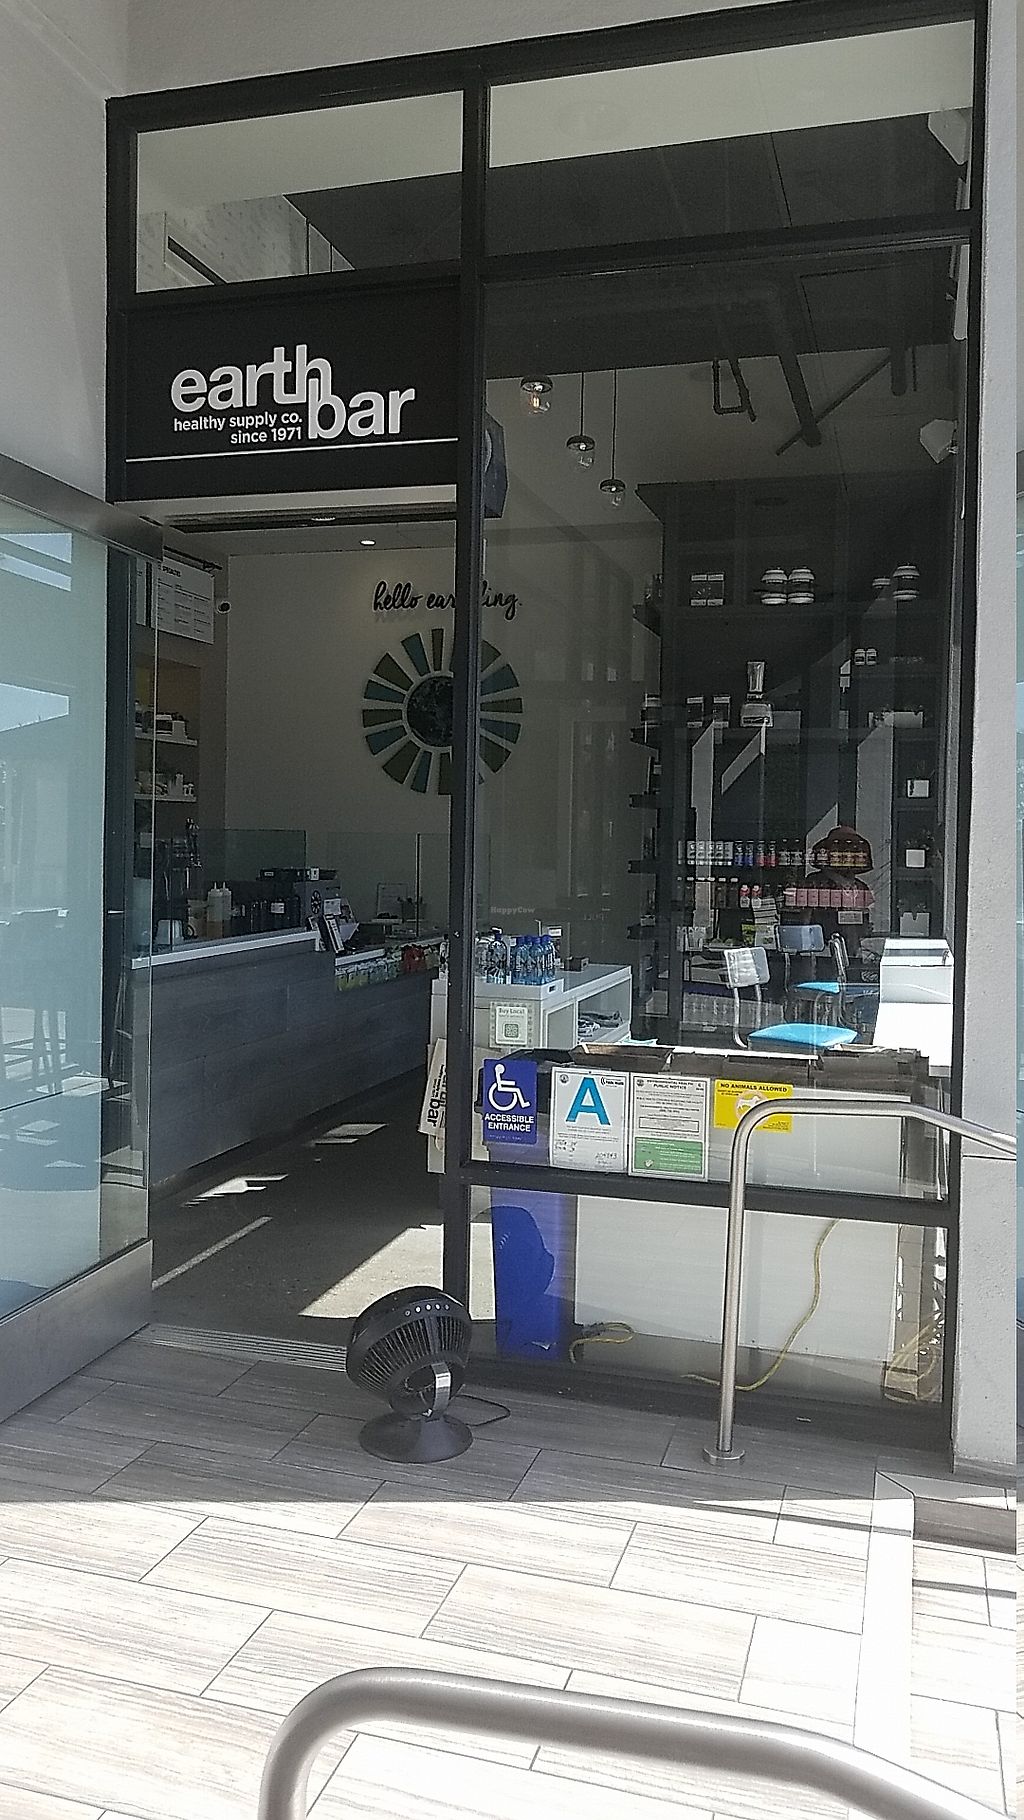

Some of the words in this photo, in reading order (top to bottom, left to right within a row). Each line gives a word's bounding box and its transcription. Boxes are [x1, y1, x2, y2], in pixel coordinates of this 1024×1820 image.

[171, 344, 332, 412] earth
[174, 415, 225, 432] healthy
[229, 411, 277, 429] supply
[281, 411, 302, 424] co.
[308, 378, 416, 439] bar
[230, 430, 267, 444] since
[271, 426, 302, 442] 1971
[373, 580, 423, 611] hello
[565, 1076, 611, 1126] A
[484, 1112, 535, 1124] ACCESSIBLE
[487, 1121, 531, 1132] ENTRANCE
